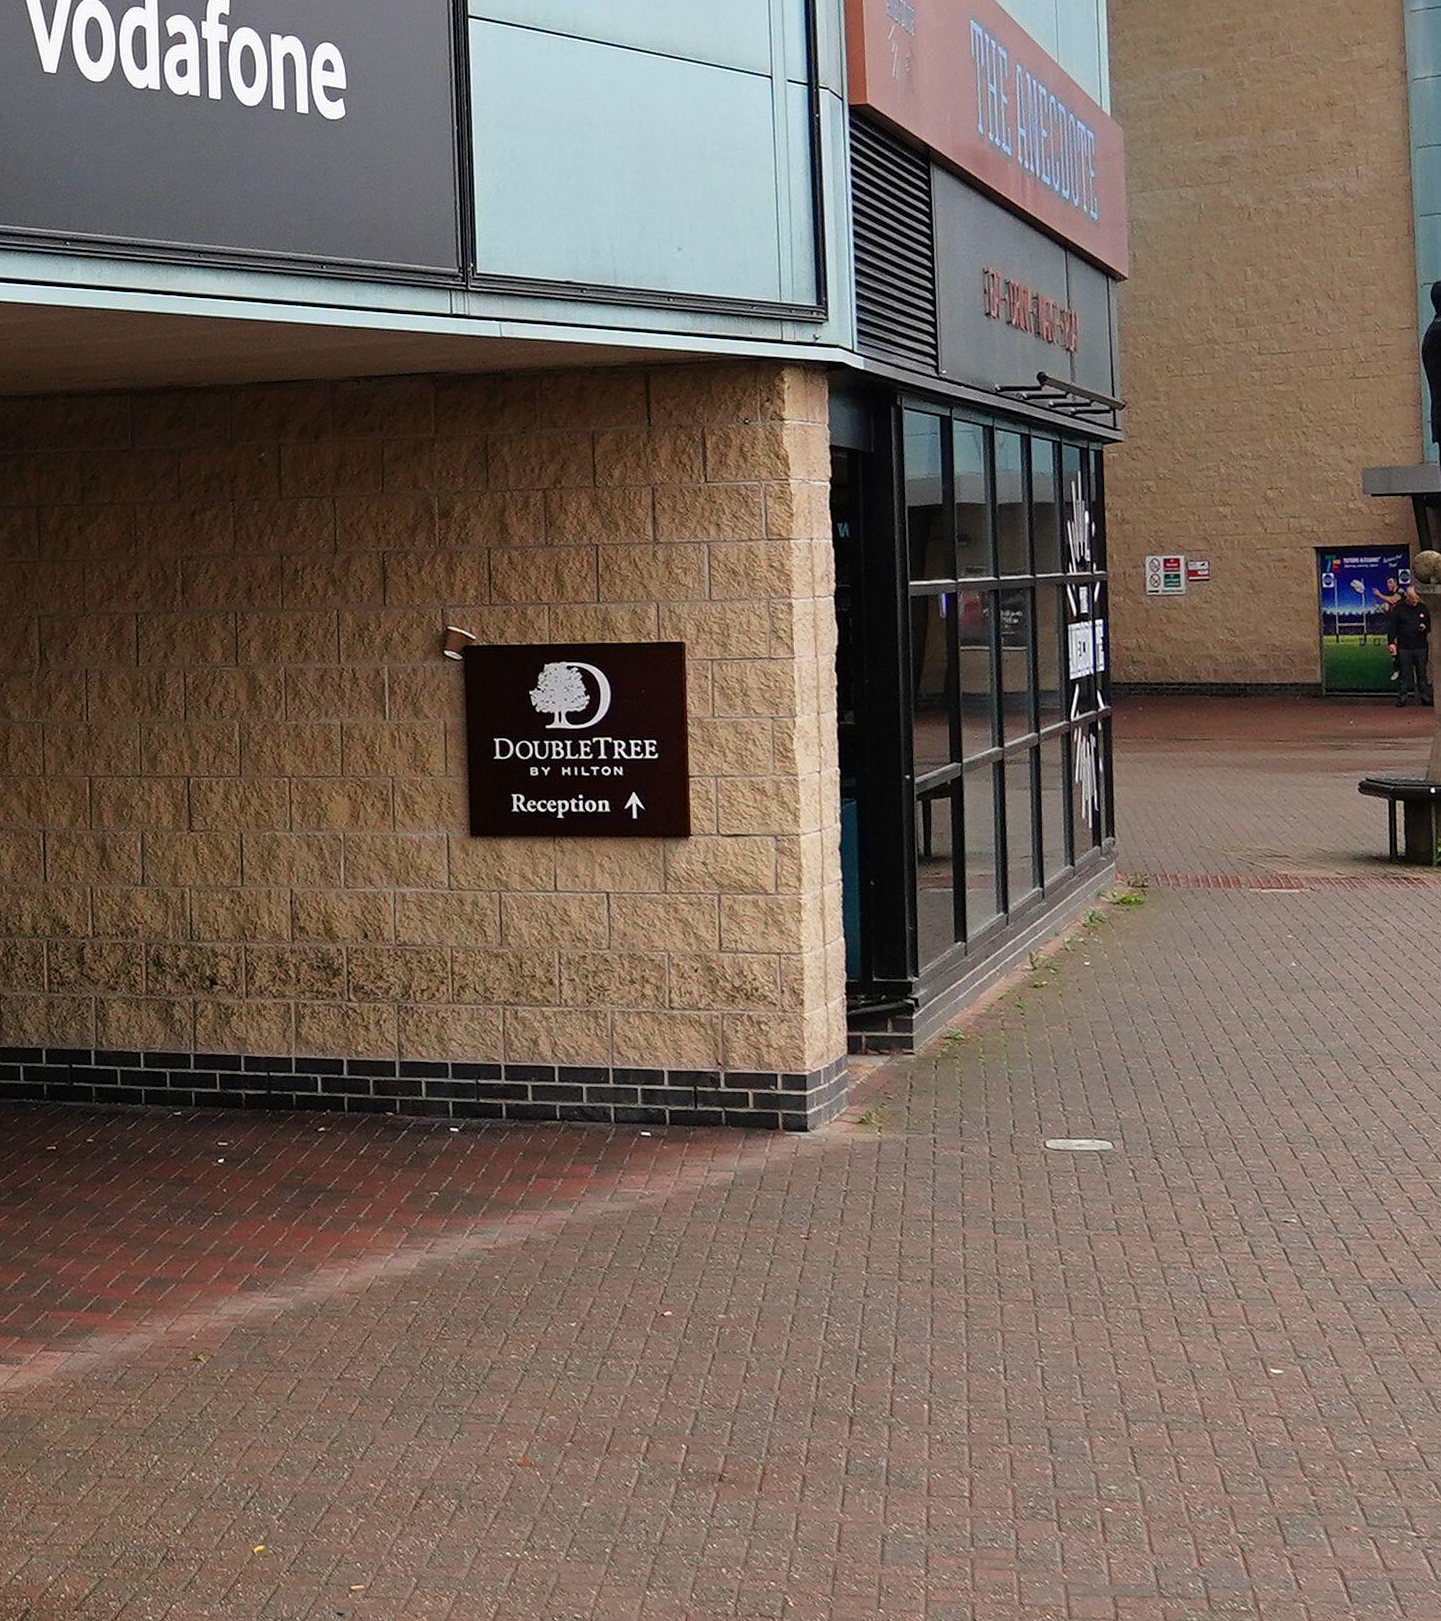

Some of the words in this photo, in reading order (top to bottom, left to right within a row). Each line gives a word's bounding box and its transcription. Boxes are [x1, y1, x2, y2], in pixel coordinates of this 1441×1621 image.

[969, 18, 1013, 156] THE
[1016, 63, 1099, 221] ANECDOTE
[528, 765, 552, 777] BY
[561, 765, 625, 777] HILTON
[510, 793, 612, 819] Reception
